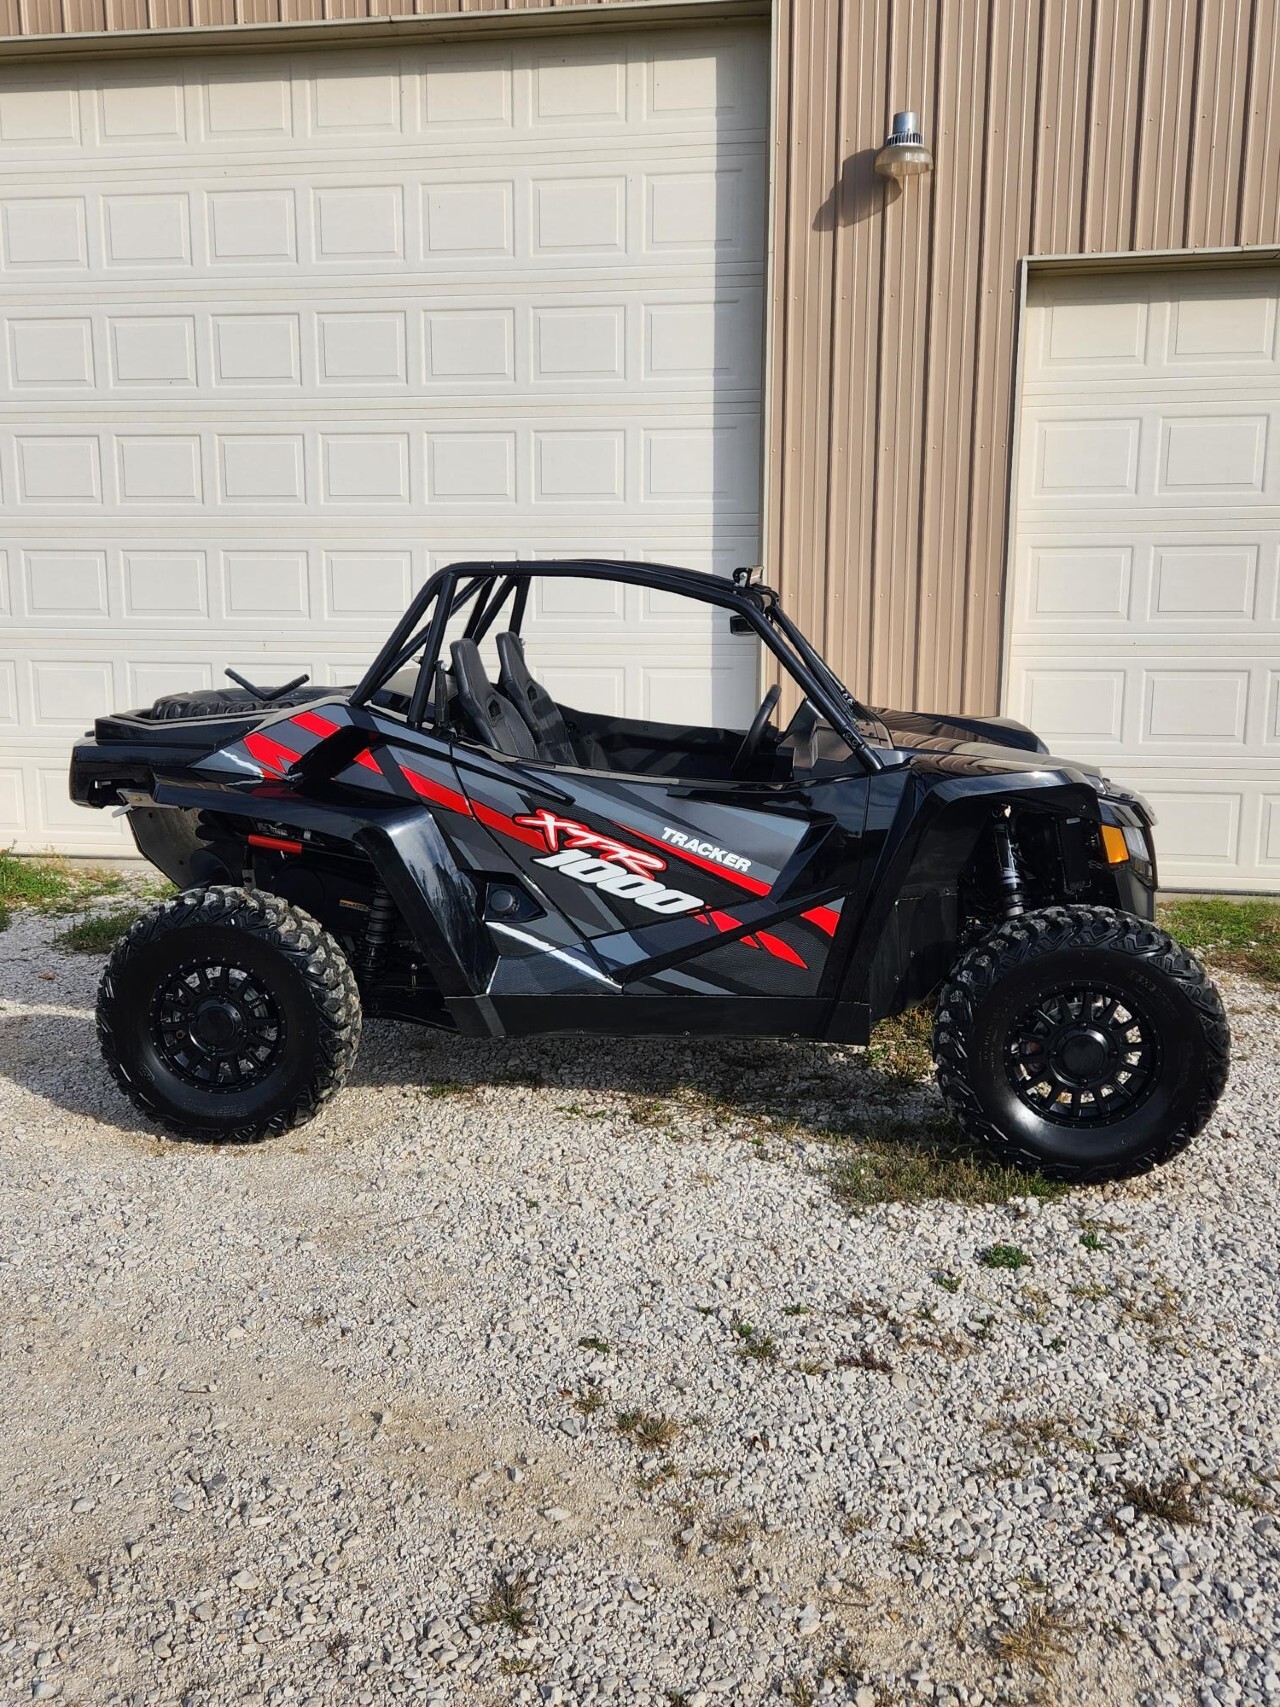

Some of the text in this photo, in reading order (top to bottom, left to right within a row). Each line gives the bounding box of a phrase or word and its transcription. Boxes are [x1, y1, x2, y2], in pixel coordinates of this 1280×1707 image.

[513, 810, 667, 880] XTR
[661, 826, 752, 872] TRACKER
[532, 849, 705, 914] 1000
